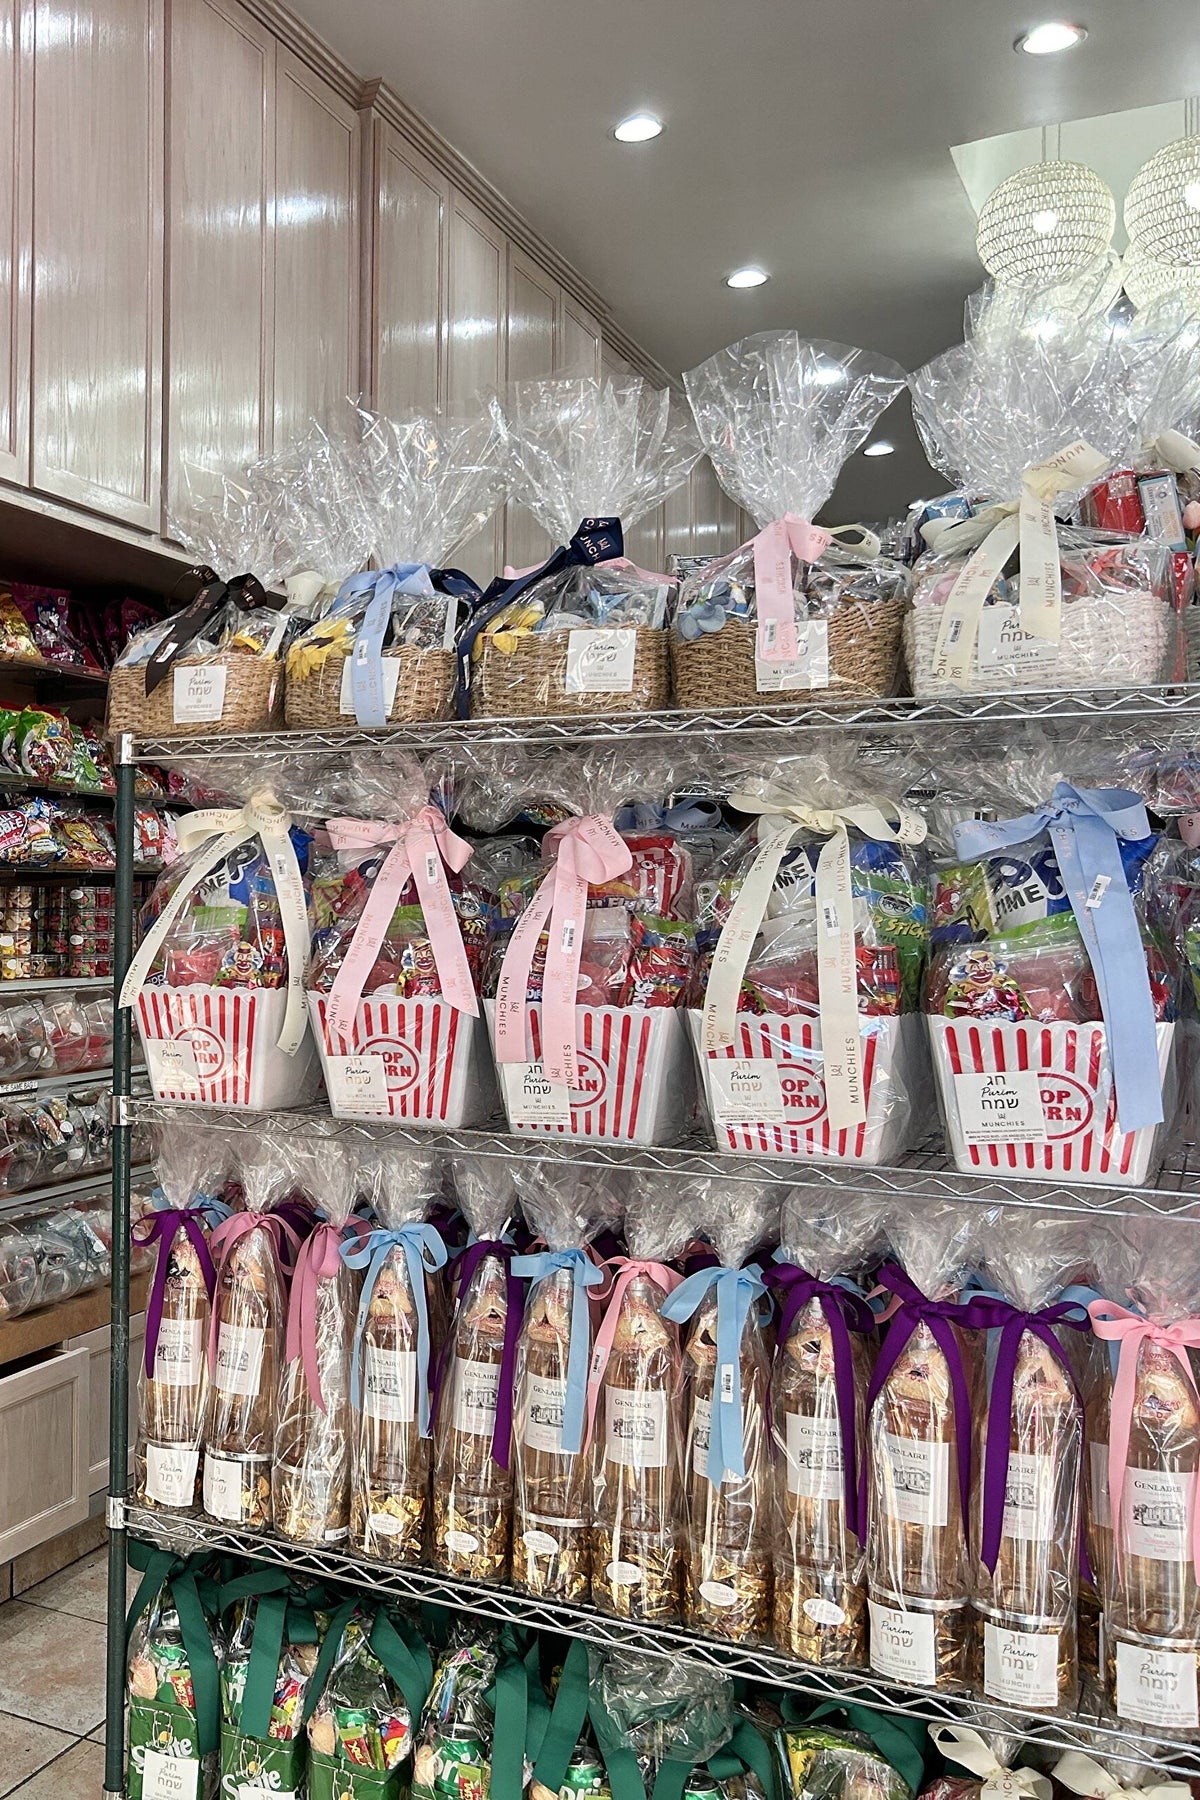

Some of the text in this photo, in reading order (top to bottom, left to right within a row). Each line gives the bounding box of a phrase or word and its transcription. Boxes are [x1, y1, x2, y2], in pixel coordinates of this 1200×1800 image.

[1047, 560, 1056, 608] MUNCHIES
[997, 651, 1039, 661] MUNCHIES
[186, 685, 212, 697] שמח
[513, 894, 542, 942] MUNCHIES
[842, 931, 852, 995] MUNCHIES
[119, 963, 138, 1008] MUNCHIE
[499, 976, 510, 1036] MUNCHIES
[192, 1039, 211, 1051] OP
[344, 1067, 370, 1076] Purim
[388, 1065, 412, 1078] RN
[528, 1065, 542, 1074] חג
[563, 1043, 575, 1089] NCHIES
[735, 1060, 751, 1071] חג
[844, 1037, 858, 1104] MUNCHIES
[730, 1070, 761, 1081] Purim
[987, 1075, 1006, 1086] חג
[523, 1086, 552, 1095] שמח
[730, 1081, 763, 1092] שמח
[781, 1079, 810, 1093] OP
[981, 1086, 1018, 1098] Purim
[782, 1094, 820, 1109] ORN
[1040, 1089, 1071, 1104] OP
[981, 1098, 1019, 1110] שמח
[1043, 1106, 1082, 1121] RN
[881, 1622, 914, 1637] Purim
[880, 1633, 914, 1648] שמח
[1009, 1633, 1028, 1645] חג
[1003, 1644, 1039, 1658] Purim
[1001, 1655, 1039, 1671] שמח
[1140, 1663, 1178, 1679] Purim
[164, 1760, 177, 1772] חג
[157, 1777, 183, 1790] שמח
